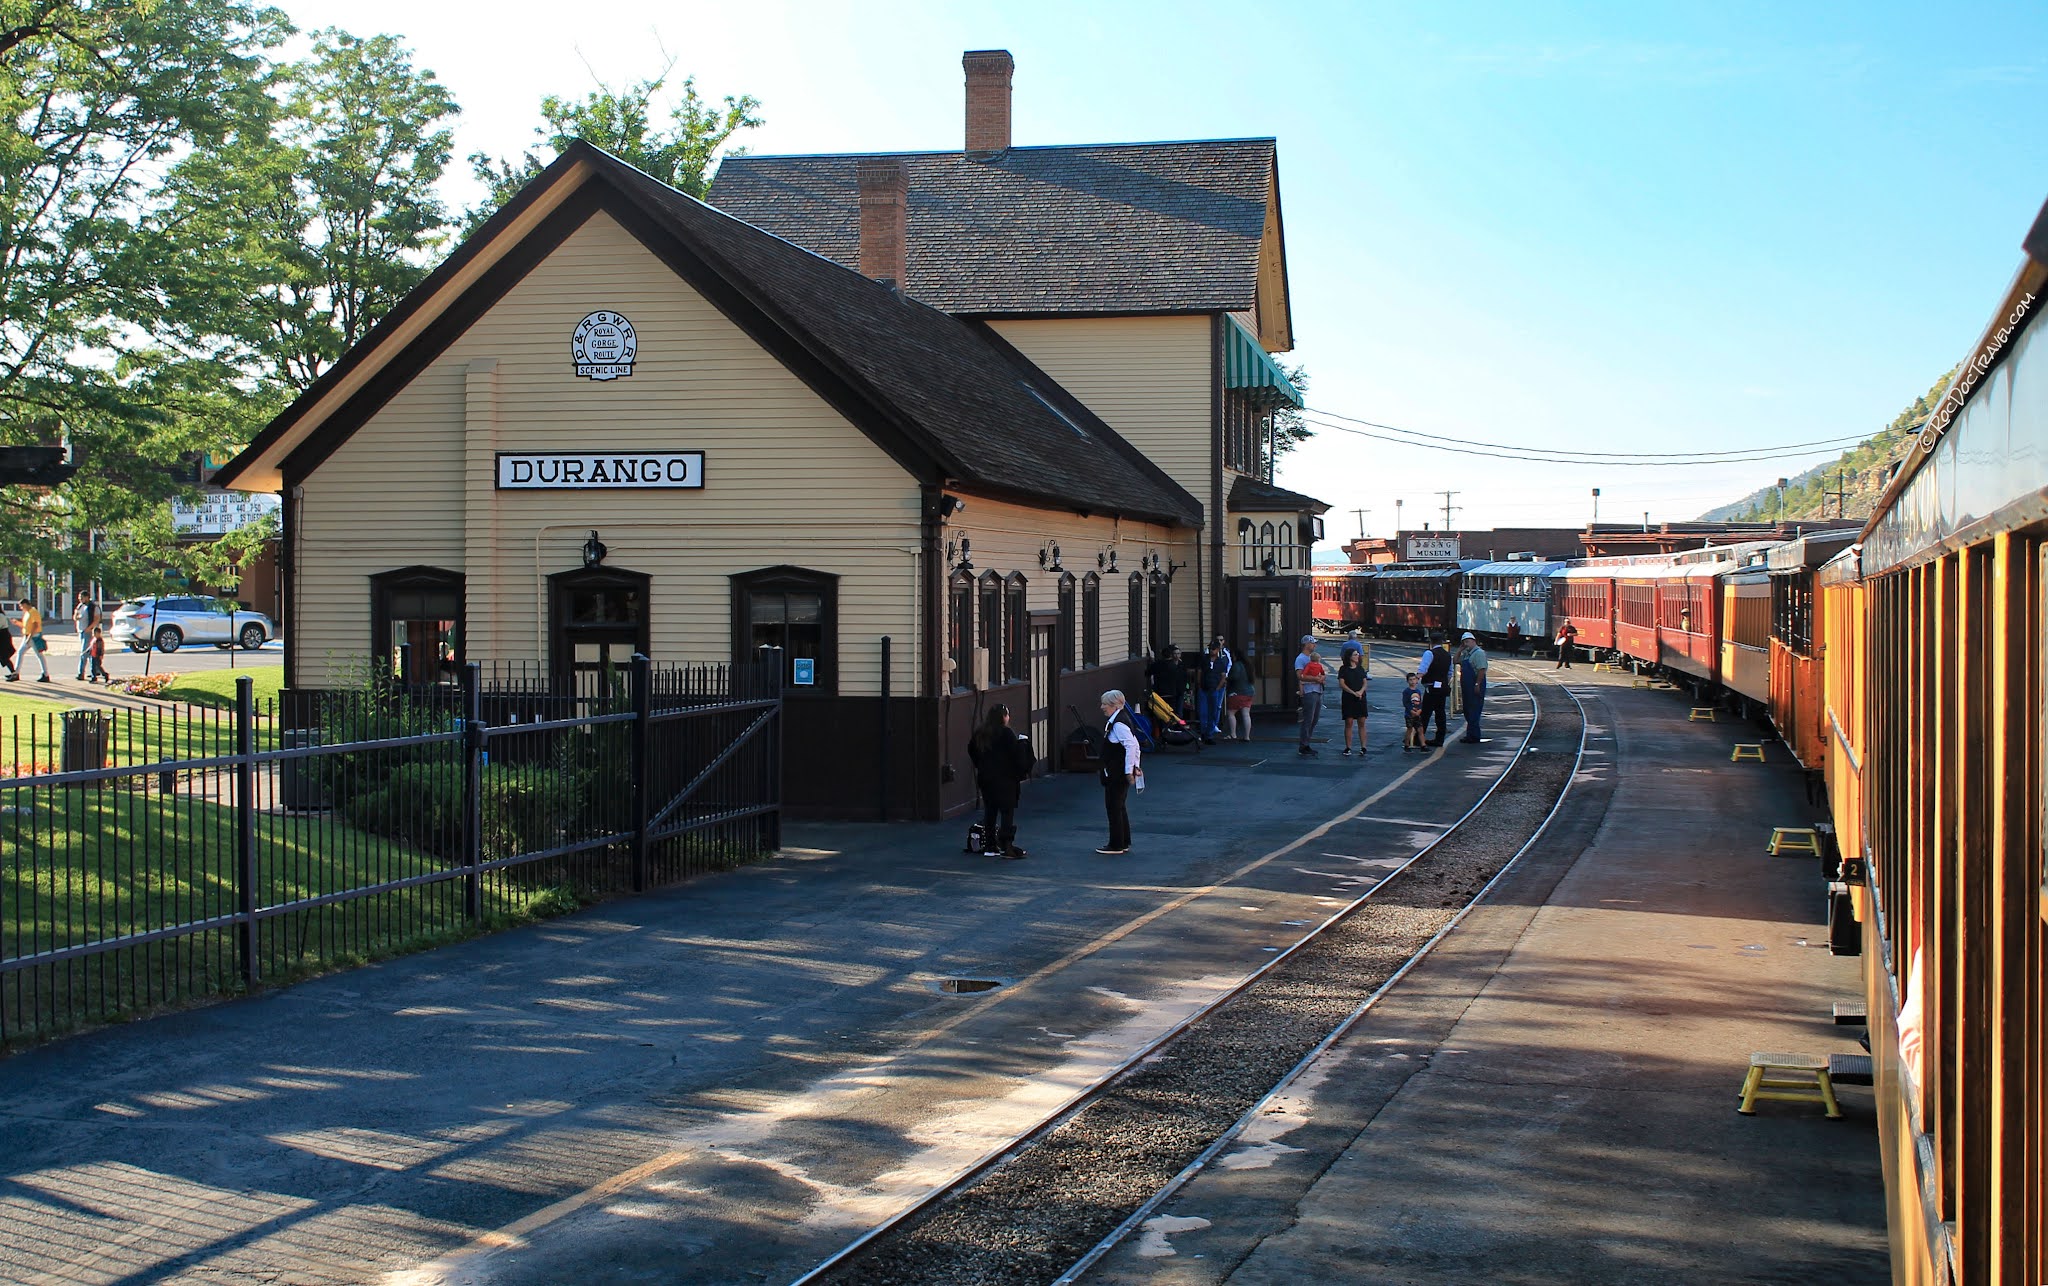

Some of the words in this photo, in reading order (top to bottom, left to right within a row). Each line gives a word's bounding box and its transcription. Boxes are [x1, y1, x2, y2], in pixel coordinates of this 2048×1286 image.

[593, 328, 616, 337] ROYAL
[591, 339, 618, 348] GORGE
[593, 350, 617, 359] ROUTE
[580, 366, 608, 374] SCENIC
[610, 365, 628, 374] LINE
[510, 459, 687, 483] DURANGO
[1850, 863, 1858, 876] 2
